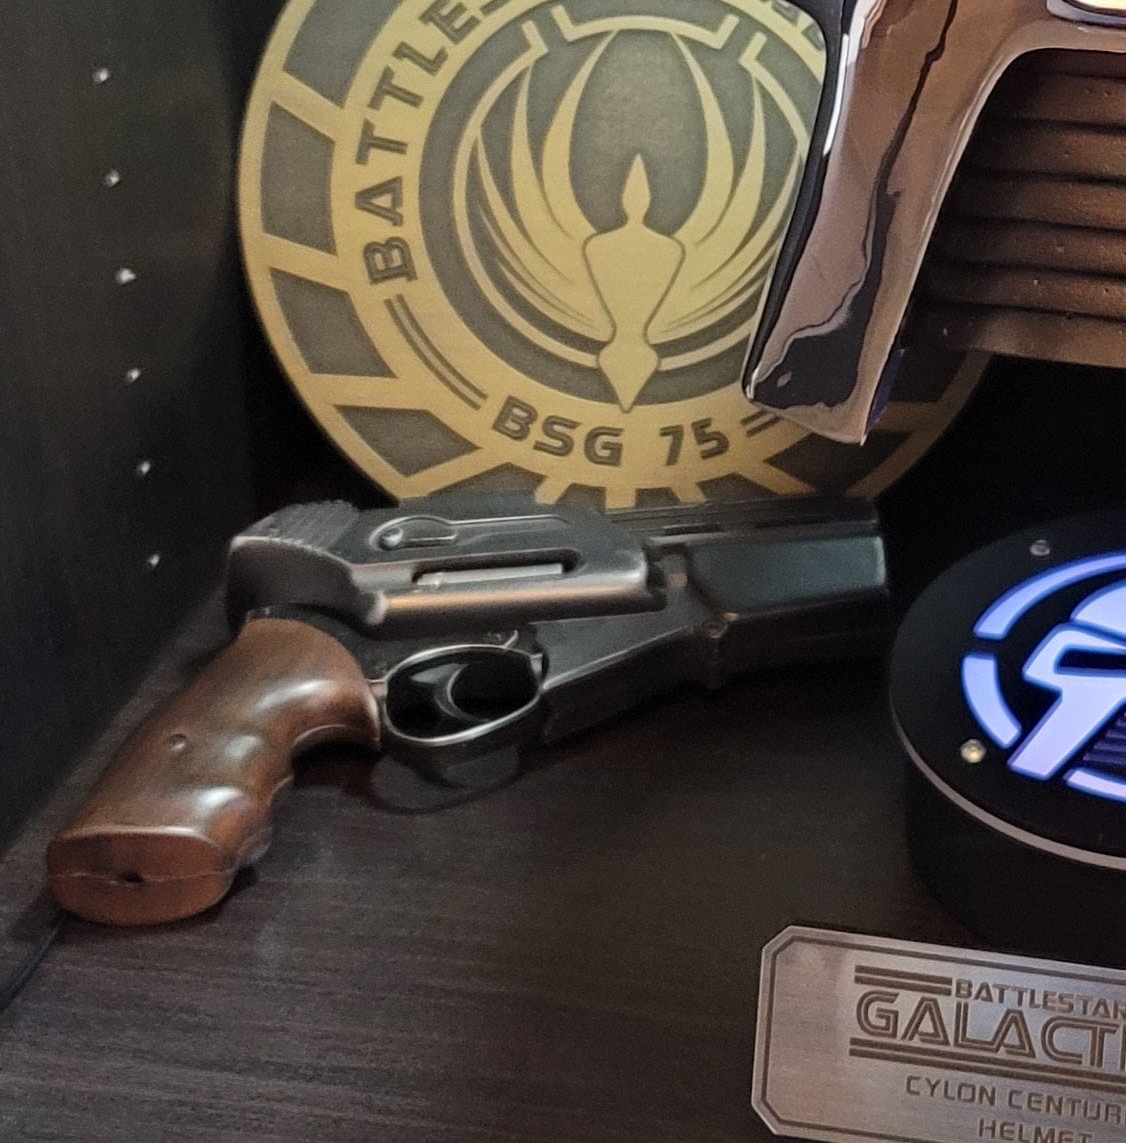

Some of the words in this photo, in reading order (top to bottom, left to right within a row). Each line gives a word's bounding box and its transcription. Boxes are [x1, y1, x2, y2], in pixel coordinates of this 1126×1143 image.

[491, 395, 625, 468] BSG
[658, 419, 730, 466] 75
[905, 1074, 997, 1107] CYLON
